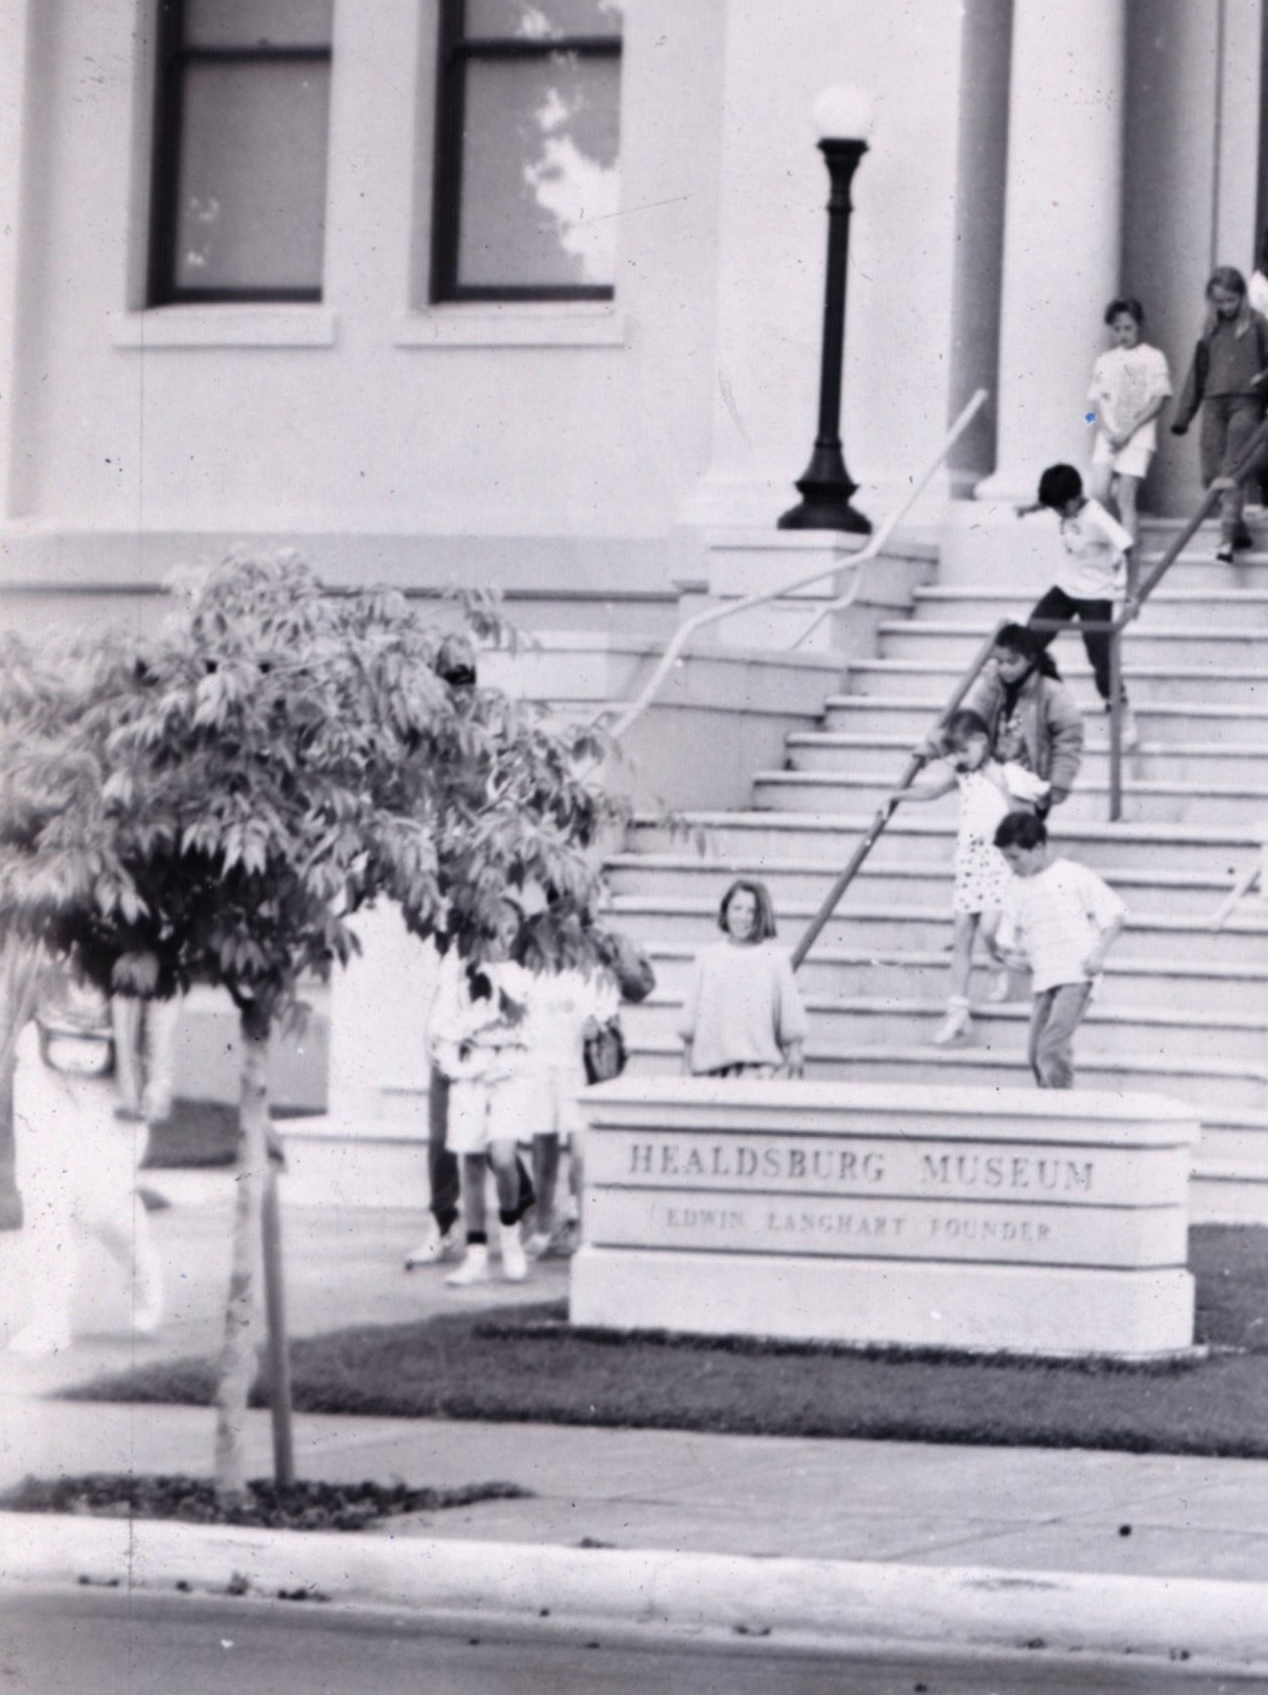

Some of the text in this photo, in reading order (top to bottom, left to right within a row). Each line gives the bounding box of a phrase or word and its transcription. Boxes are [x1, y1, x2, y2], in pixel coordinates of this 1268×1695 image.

[627, 1143, 1096, 1193] HEALDSBURG MUSEUM
[665, 1207, 745, 1231] EDWIN
[928, 1217, 1052, 1243] FOUNDER
